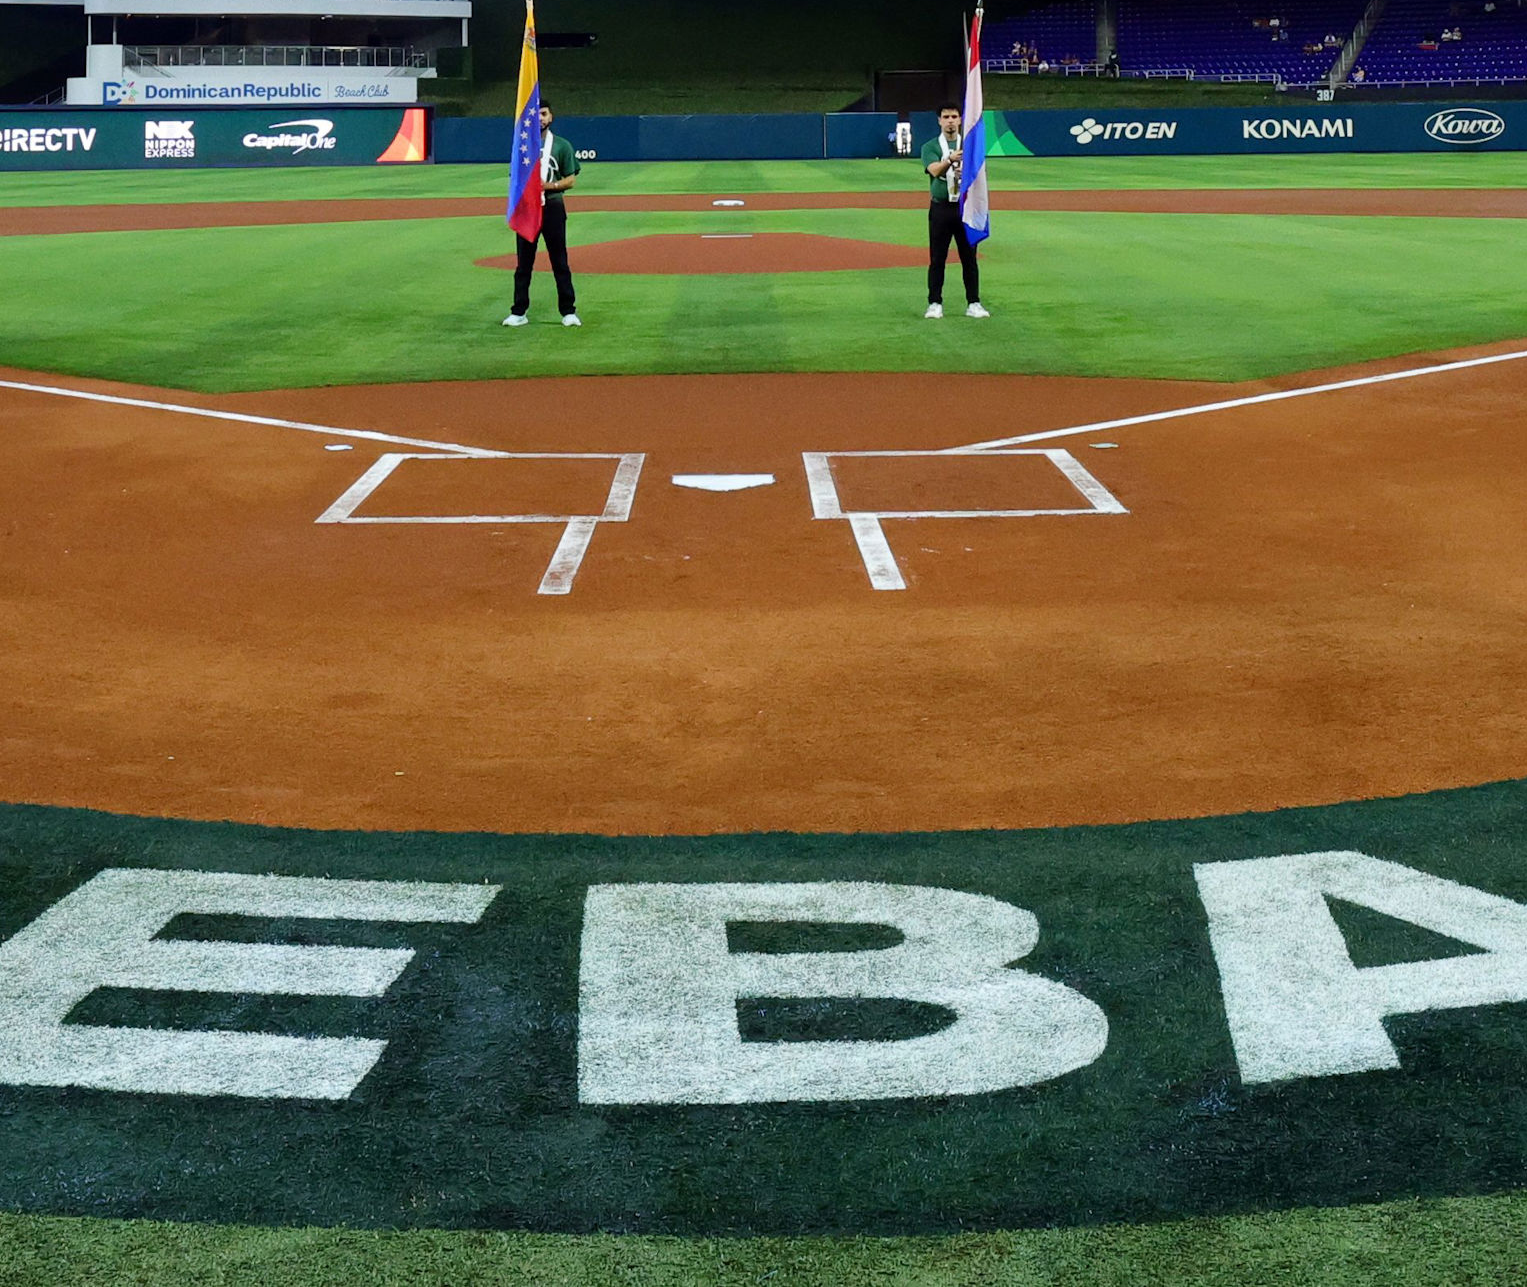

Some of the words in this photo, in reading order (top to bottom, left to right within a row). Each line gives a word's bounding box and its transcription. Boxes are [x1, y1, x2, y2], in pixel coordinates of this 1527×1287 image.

[334, 84, 366, 98] Beach
[367, 83, 390, 98] Club
[1316, 89, 1336, 102] 387
[1242, 117, 1354, 140] KONAMI
[1430, 110, 1503, 136] Kowa
[1103, 121, 1143, 141] ITO
[1144, 121, 1177, 141] EN
[144, 140, 195, 150] NIPPON
[144, 148, 195, 159] EXPRESS
[575, 149, 596, 160] 400
